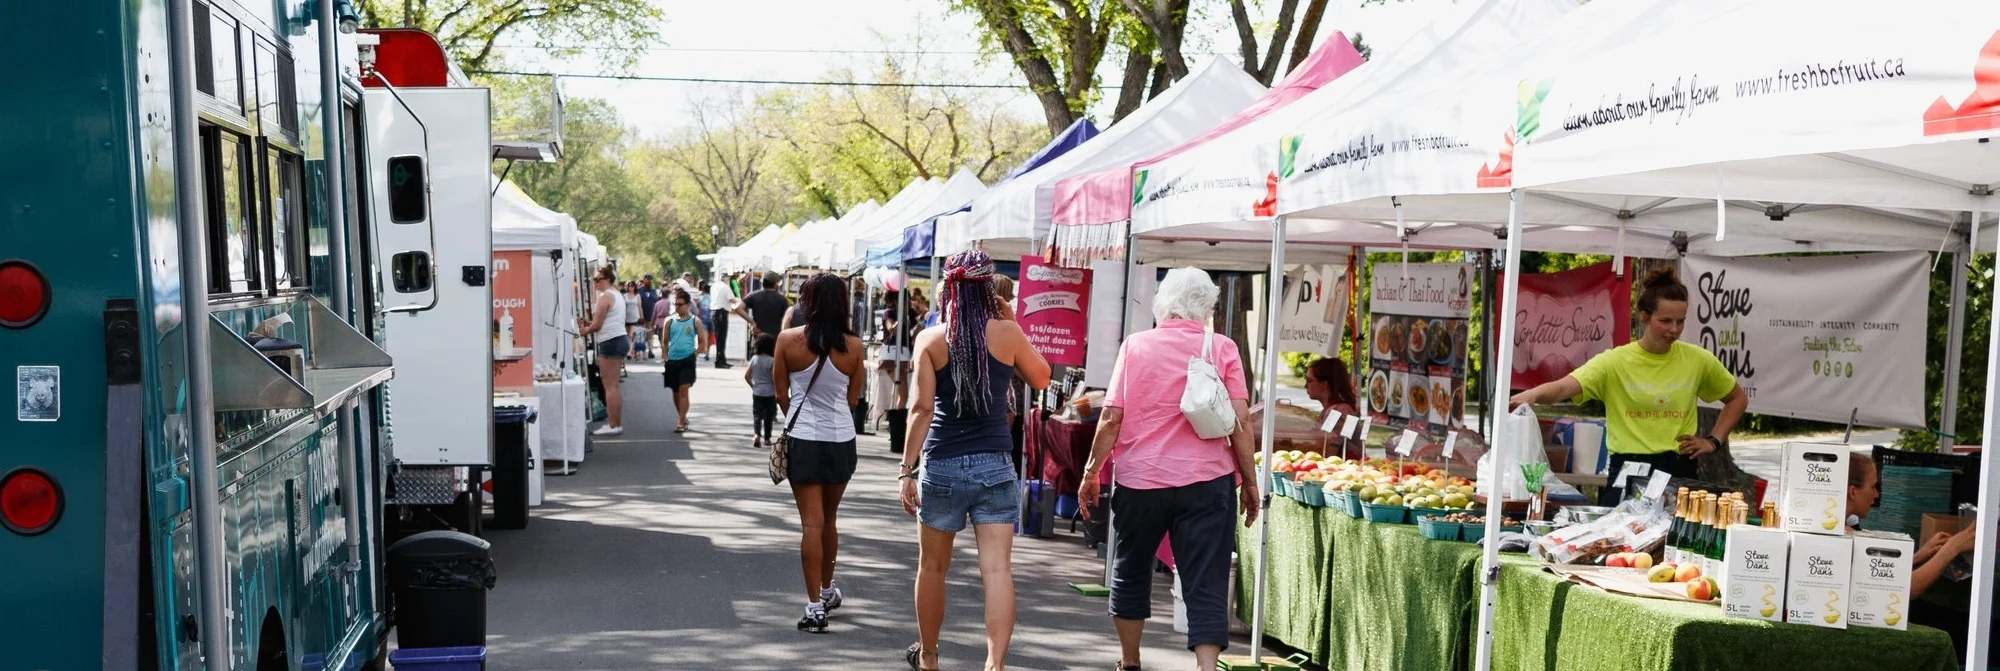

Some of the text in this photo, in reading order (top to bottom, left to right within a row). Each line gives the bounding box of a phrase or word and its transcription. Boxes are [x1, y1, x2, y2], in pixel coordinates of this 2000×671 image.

[1563, 57, 1906, 131] learn about our family farm www.freshbcfruit.ca
[1375, 276, 1397, 301] Indian
[1409, 277, 1426, 302] Thai
[1426, 278, 1445, 303] Food
[1697, 269, 1753, 324] Steve
[1039, 299, 1065, 307] COOKIES
[1029, 324, 1071, 336] $16/dozen
[1718, 314, 1740, 347] and
[1769, 319, 1900, 332] SUSTAINABILITY INTEGRITY COMMUNITY
[1514, 307, 1606, 361] Confetti Sweets
[1053, 336, 1077, 346] dozen
[1645, 410, 1660, 418] THE
[1806, 463, 1832, 473] Steve
[1808, 471, 1832, 483] Dan's
[1744, 550, 1770, 561] Steve
[1808, 556, 1834, 566] Steve
[1746, 559, 1770, 570] Dan's
[1869, 558, 1895, 568] Steve
[1809, 565, 1834, 576] Dan's
[1870, 567, 1895, 578] Dan's
